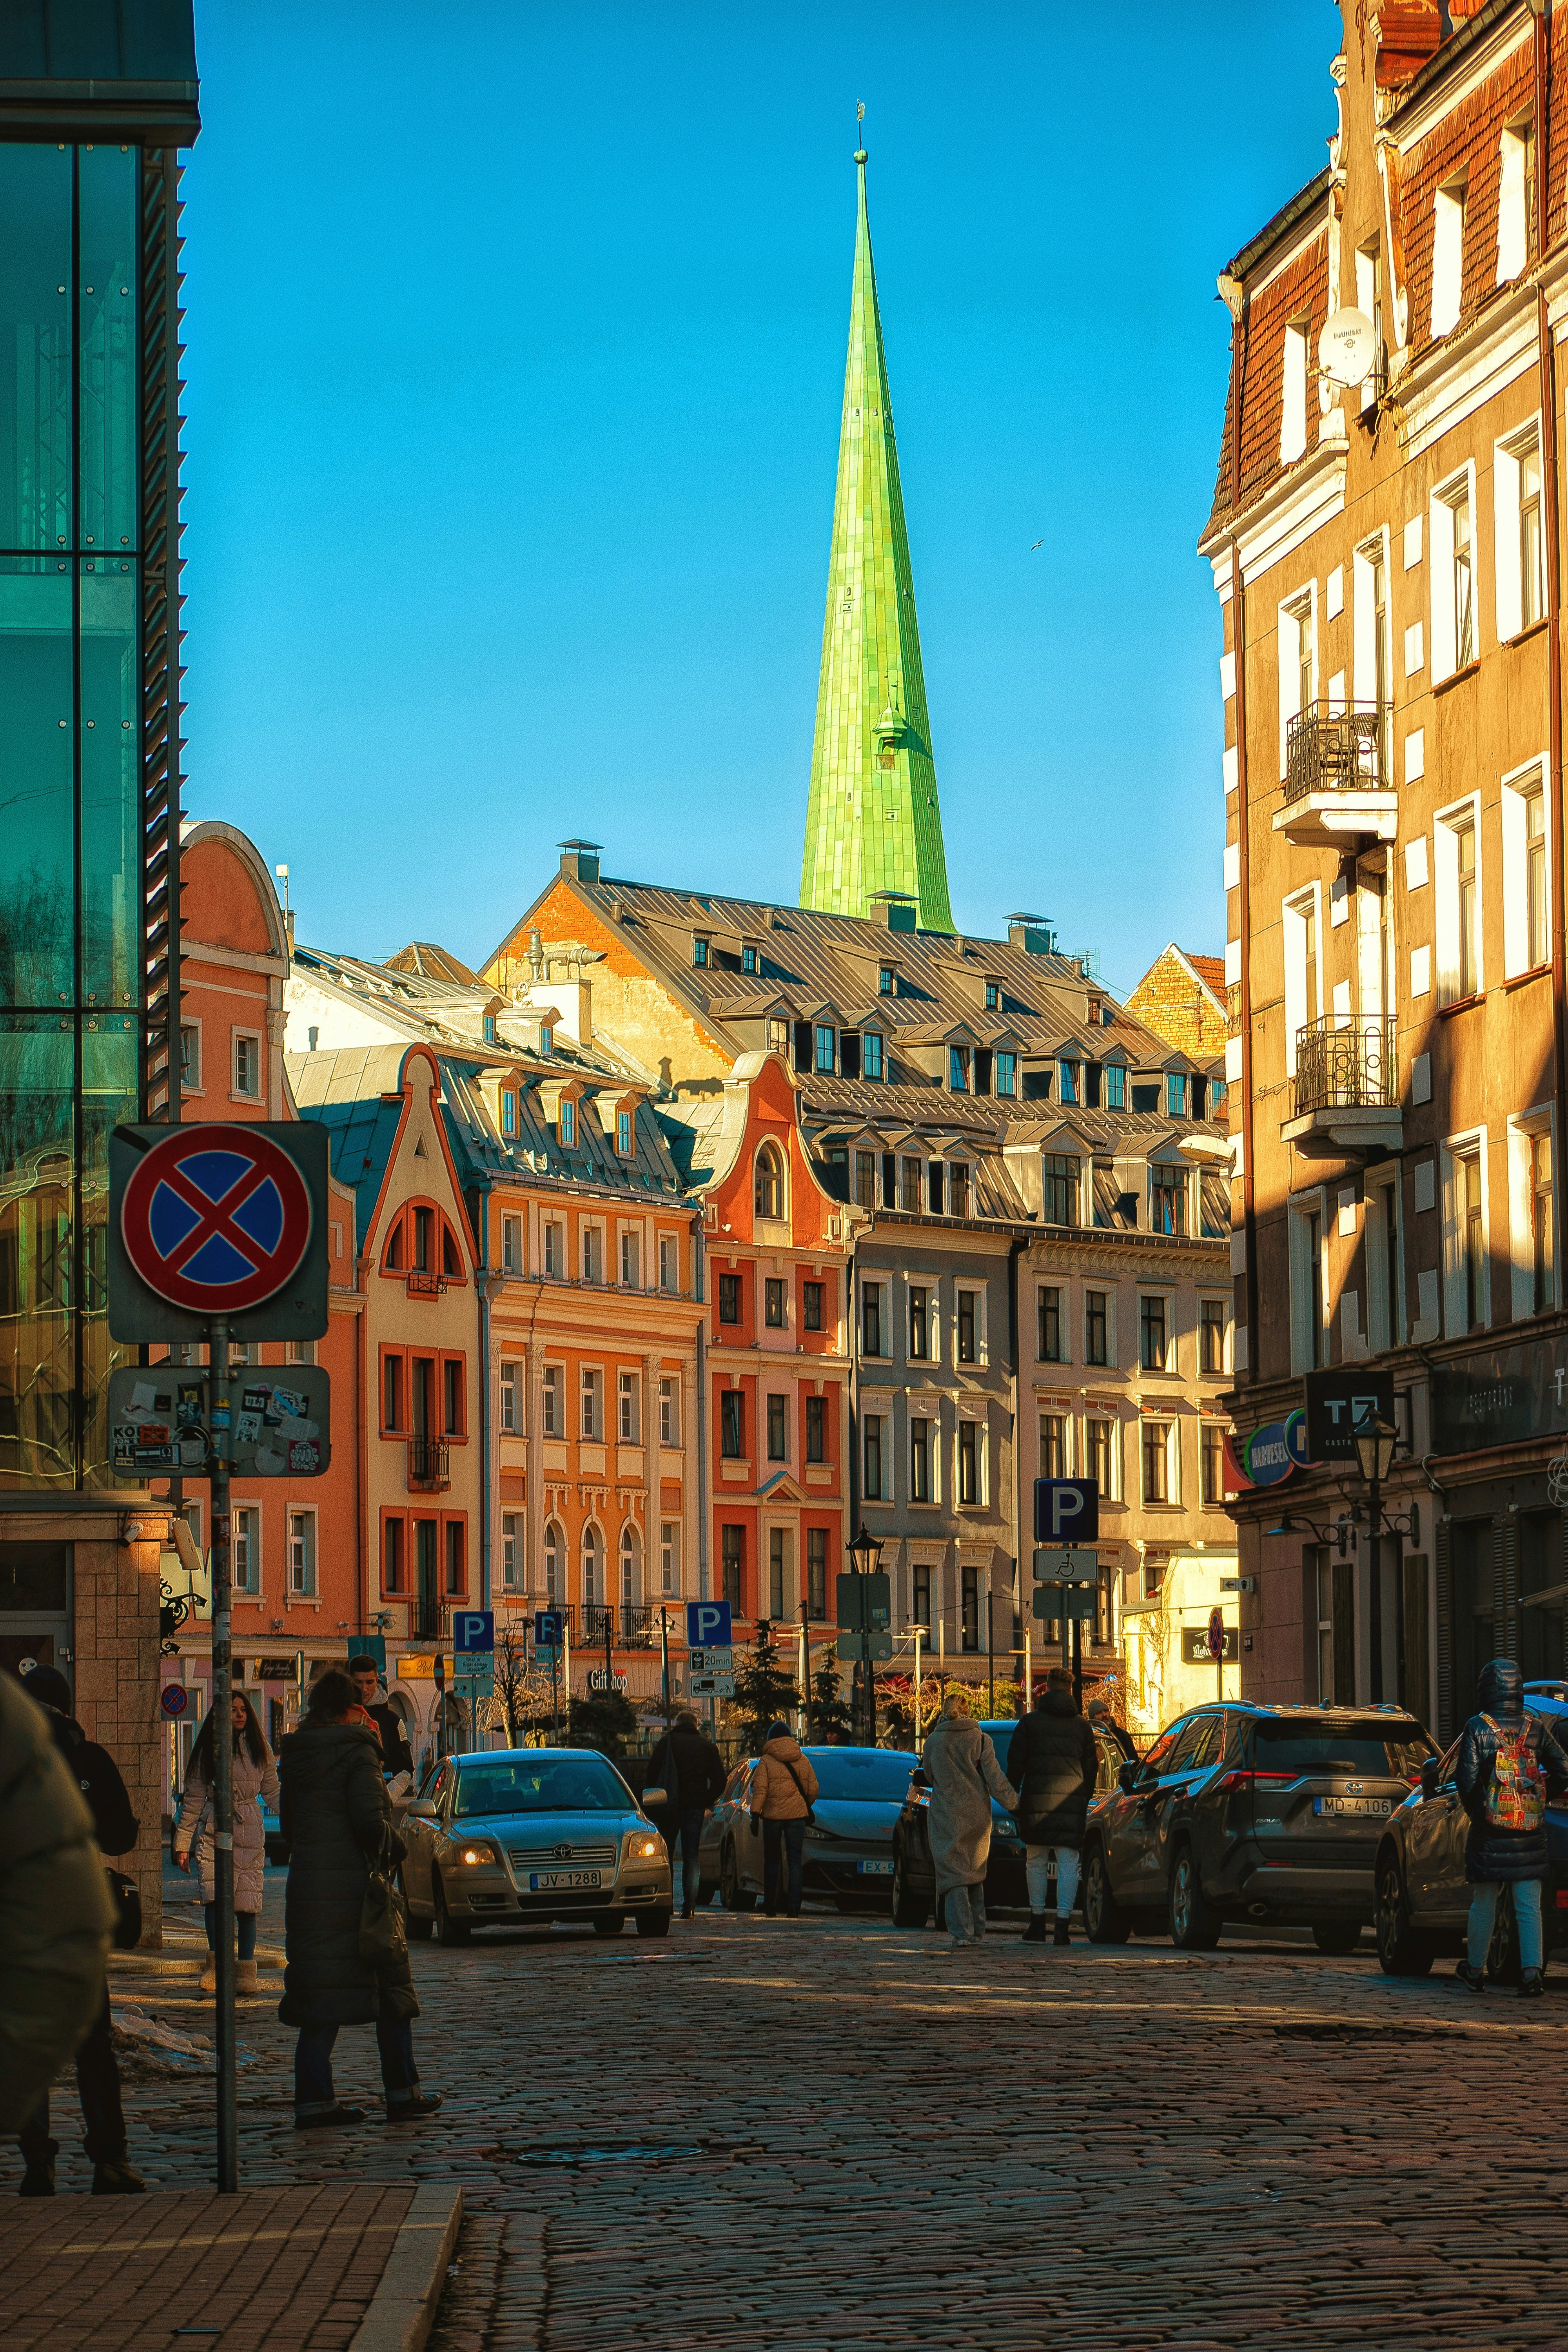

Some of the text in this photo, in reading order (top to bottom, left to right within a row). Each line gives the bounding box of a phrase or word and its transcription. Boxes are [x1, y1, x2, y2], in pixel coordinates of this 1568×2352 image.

[114, 1426, 140, 1438] KO
[1052, 1487, 1084, 1534] P
[464, 1617, 485, 1646] P
[541, 1615, 555, 1641] P
[698, 1607, 720, 1641] P
[705, 1655, 730, 1665] 20min
[591, 1669, 627, 1695] Gift hop
[1325, 1798, 1389, 1813] MD-4106
[866, 1862, 894, 1873] EX-5
[541, 1872, 598, 1887] JV-1288
